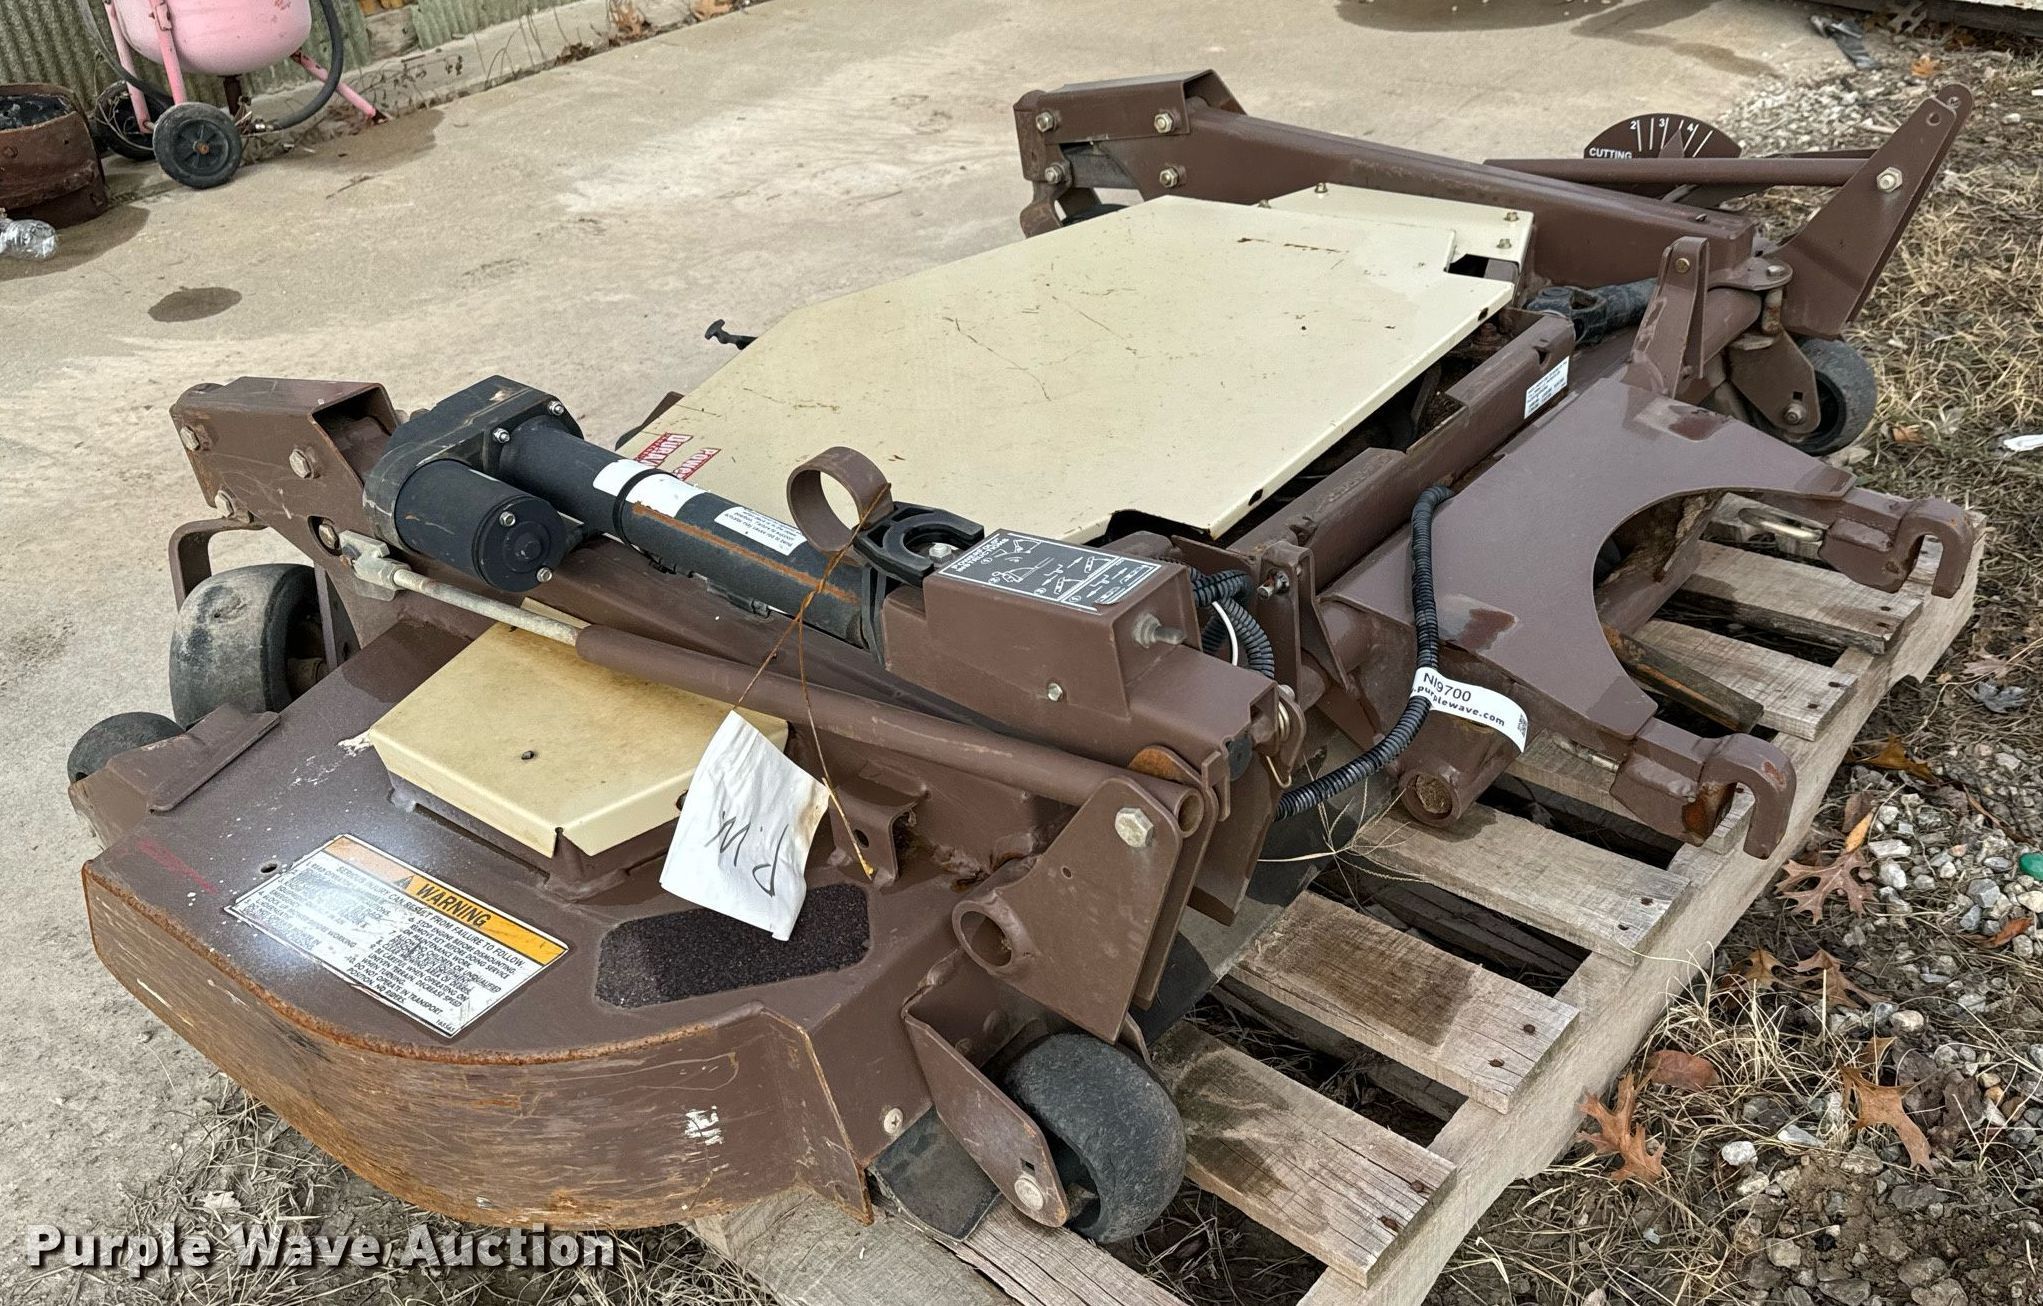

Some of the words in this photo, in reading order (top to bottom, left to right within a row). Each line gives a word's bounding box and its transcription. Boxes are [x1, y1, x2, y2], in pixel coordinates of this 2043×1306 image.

[1630, 121, 1637, 130] 2
[1659, 119, 1665, 127] 3
[1687, 123, 1694, 132] 4
[1589, 148, 1632, 159] CUTTING
[955, 539, 1009, 572] INSTRUCTIONS
[1423, 673, 1471, 702] NI9700
[415, 884, 492, 927] WARNING
[389, 894, 405, 903] CAN
[404, 902, 431, 917] RESULT
[430, 916, 453, 929] FROM
[452, 927, 483, 945] FAILURE
[481, 942, 494, 950] TO
[417, 920, 432, 929] STOP
[431, 928, 452, 940] ENGINE
[452, 939, 473, 951] BEFORE
[382, 943, 400, 954] CLEAR
[399, 953, 426, 968] MOWING
[426, 967, 442, 977] AREA
[410, 924, 433, 938] REMOVE
[444, 943, 465, 955] BEFORE
[465, 954, 485, 966] DOING
[486, 965, 508, 978] SERVICE
[412, 934, 452, 957] MAINTENANCE
[360, 958, 379, 969] WHEN
[382, 953, 407, 967] CAREFUL
[406, 965, 425, 977] WHEN
[424, 976, 457, 995] OPERATING
[456, 993, 469, 1001] ON
[396, 934, 416, 946] ALLOW
[426, 950, 454, 967] CHILDREN
[463, 970, 501, 992] UNQUALIFIED
[424, 957, 437, 966] RUN
[363, 968, 376, 977] NOT
[375, 975, 401, 991] OPERATE
[408, 993, 442, 1014] TRANSPORT
[367, 953, 392, 968] UNEVEN
[415, 980, 443, 997] DECREASE
[443, 995, 461, 1006] SPEED
[373, 983, 387, 991] NO
